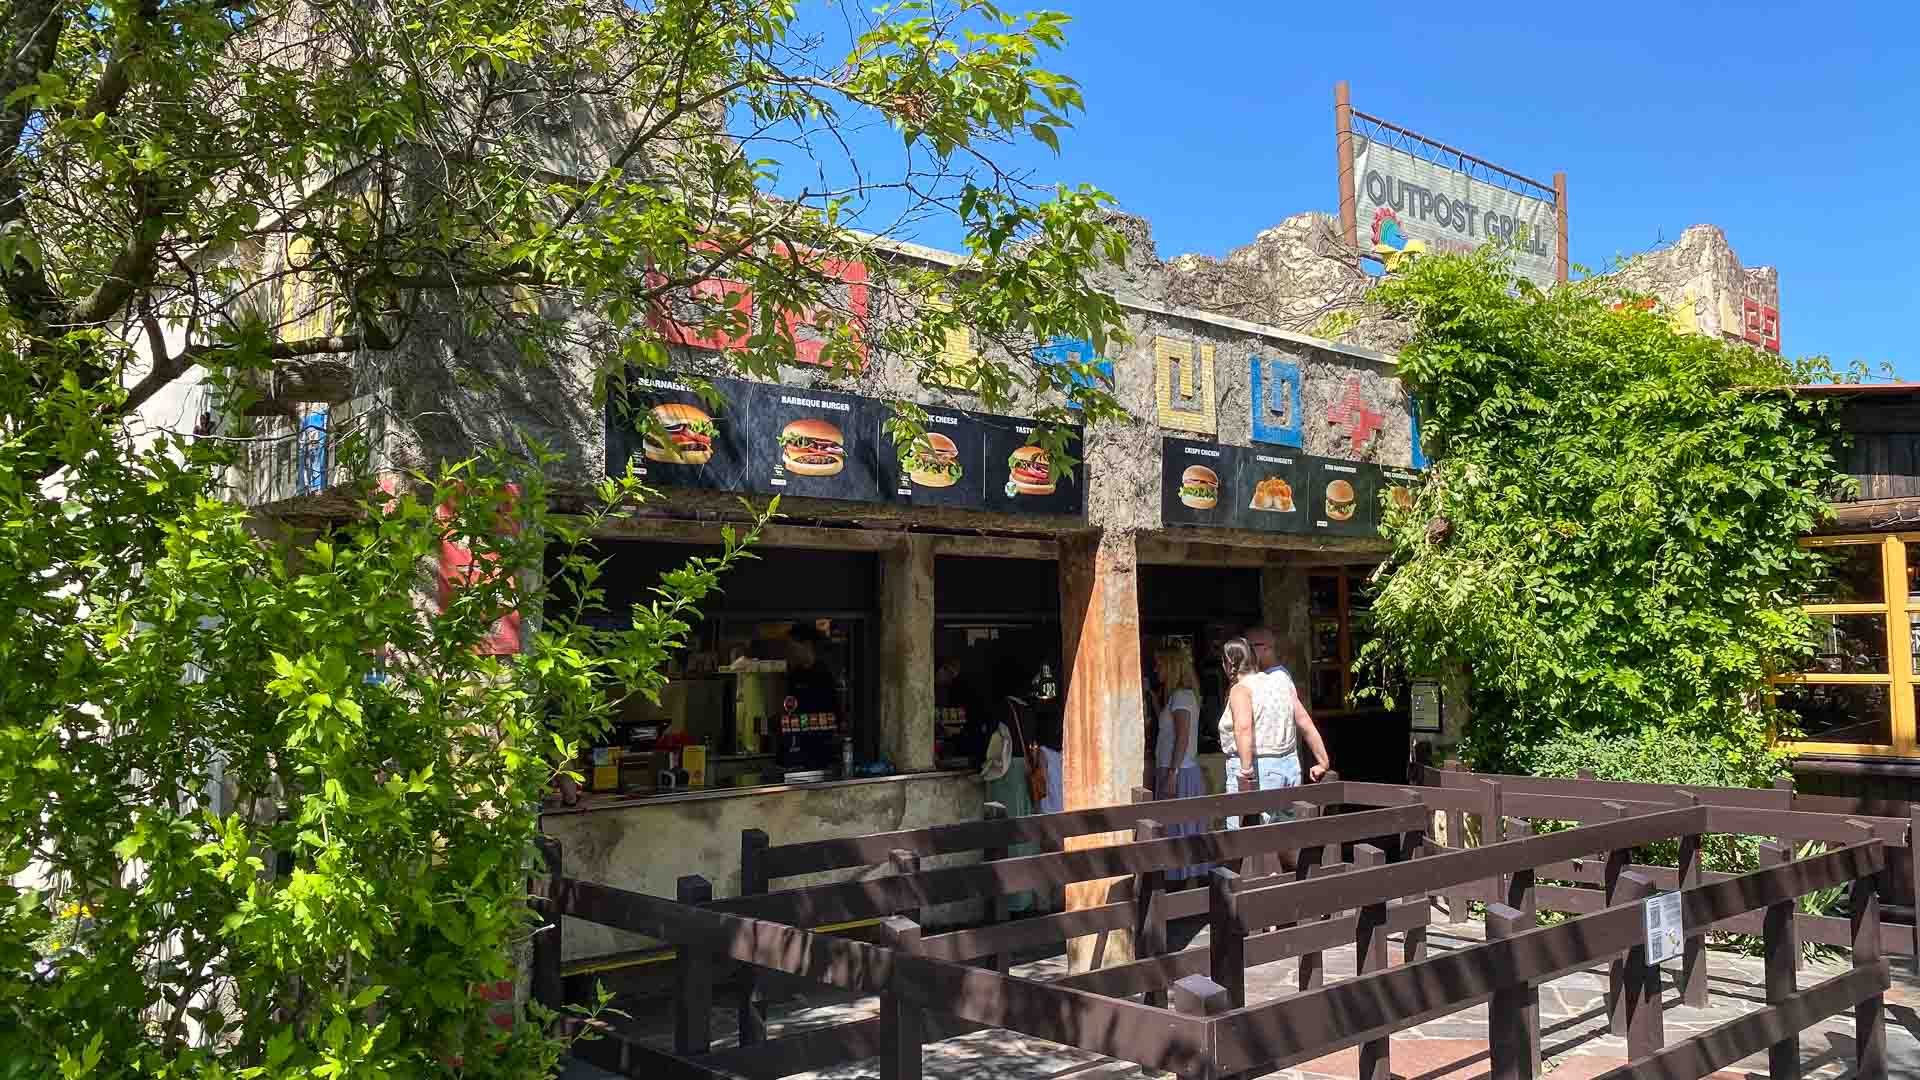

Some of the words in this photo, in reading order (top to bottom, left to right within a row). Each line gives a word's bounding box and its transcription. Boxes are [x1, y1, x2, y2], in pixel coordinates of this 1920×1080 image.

[1366, 169, 1479, 237] OUTPOST
[1483, 210, 1547, 257] GRILL
[781, 396, 820, 408] BARBEQUE
[821, 400, 850, 412] BURGER
[935, 415, 958, 425] CHEESE
[1184, 447, 1201, 456] CRISPY
[1201, 449, 1220, 457] CHICKEN
